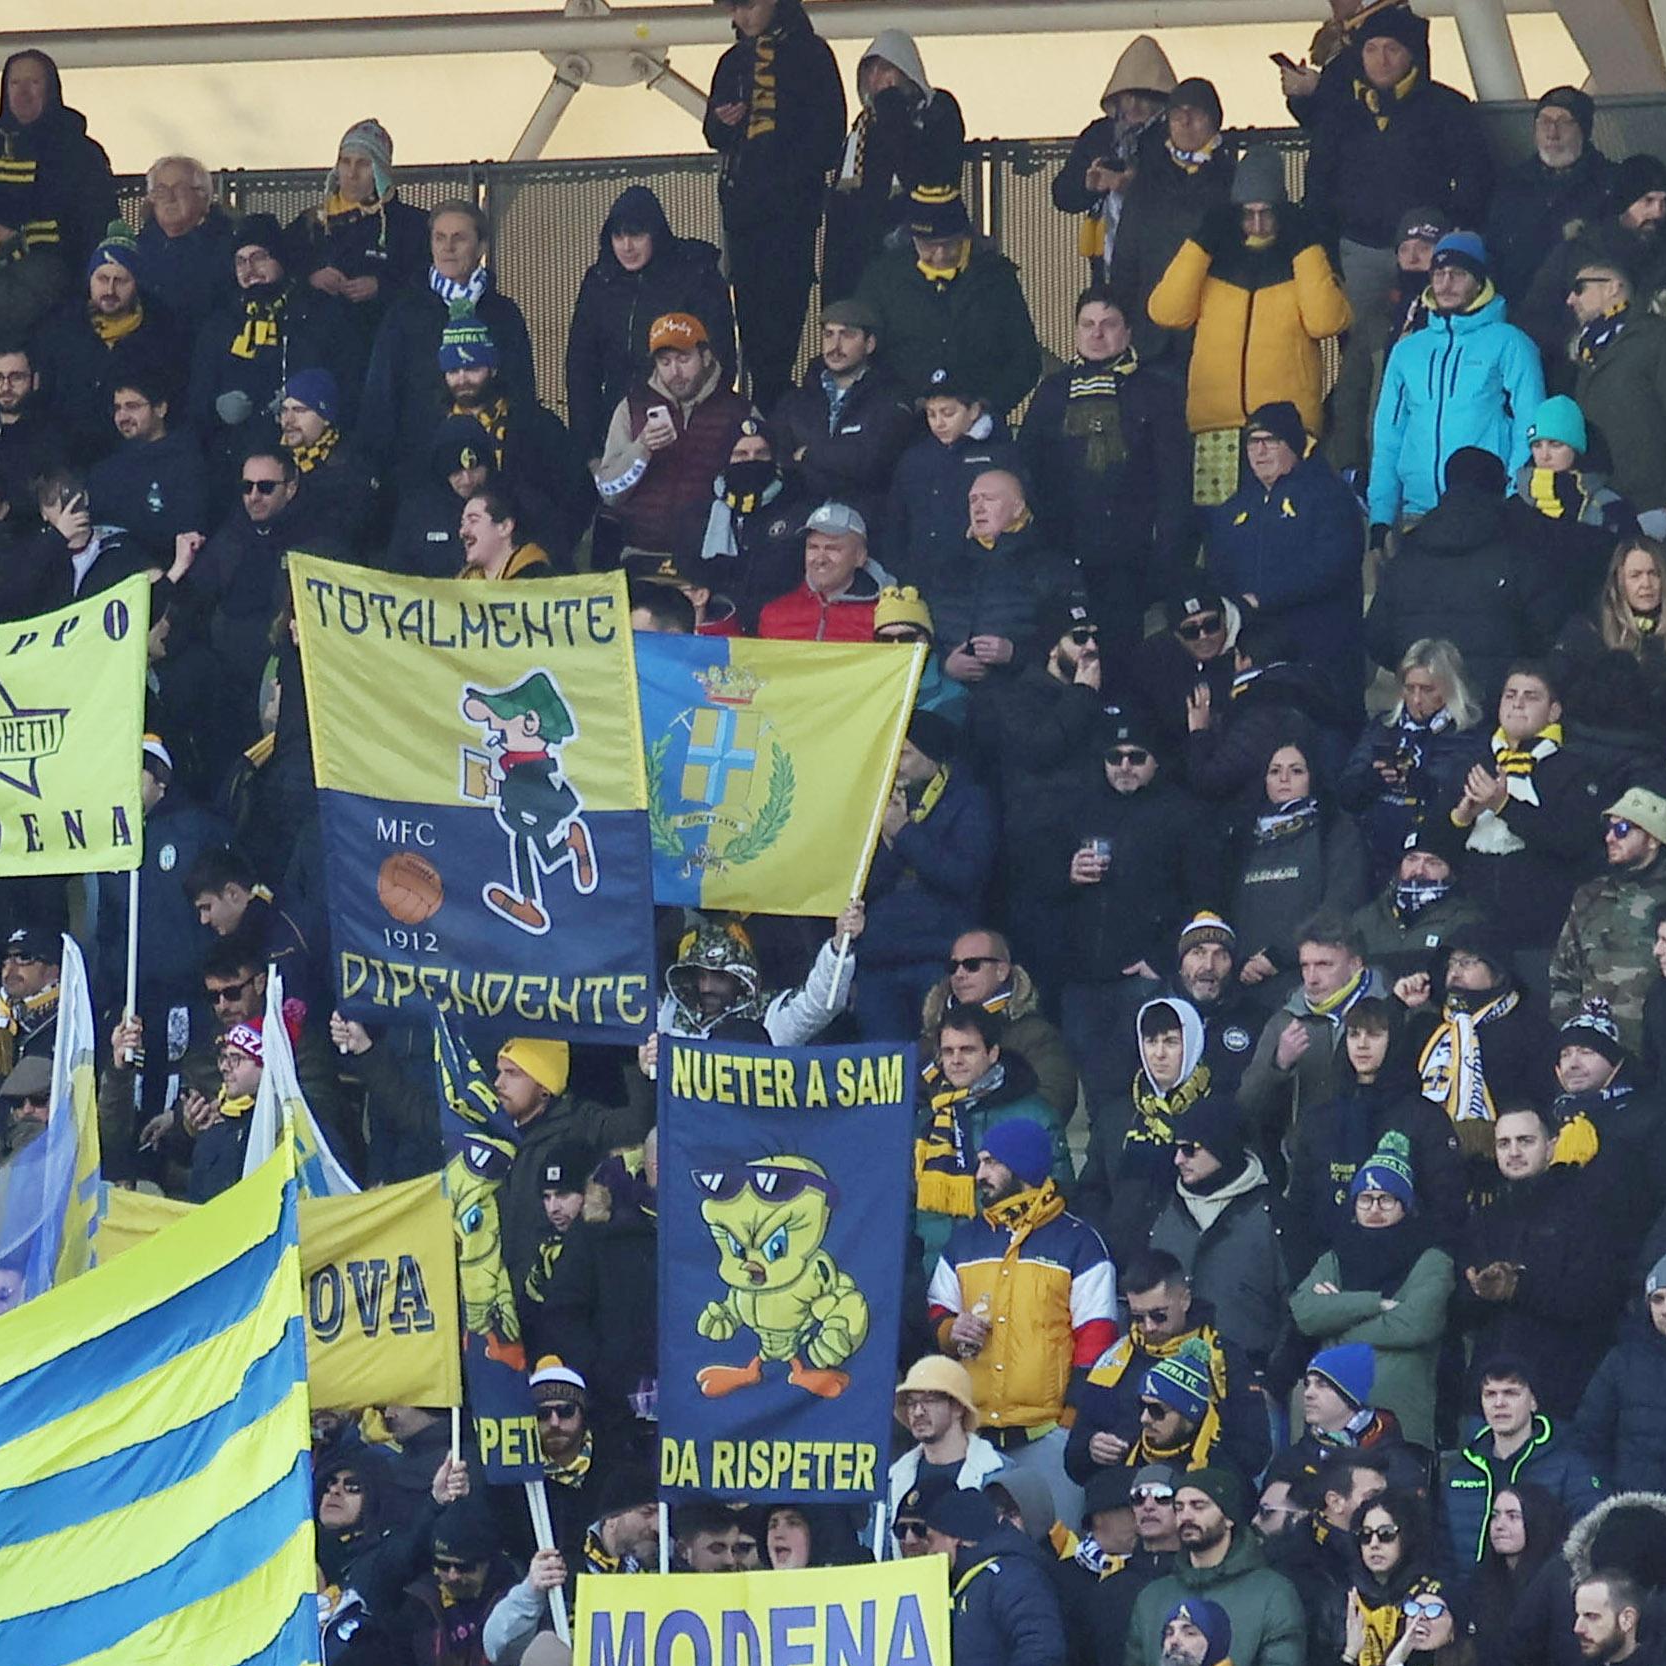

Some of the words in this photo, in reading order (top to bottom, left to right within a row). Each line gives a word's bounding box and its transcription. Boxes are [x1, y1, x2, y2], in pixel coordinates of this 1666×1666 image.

[306, 577, 618, 649] TOTALMENTE
[375, 817, 435, 847] MFC
[383, 927, 440, 952] 1912
[340, 950, 648, 1024] DIPENDENTE
[671, 1047, 795, 1108] NUETER
[806, 1061, 828, 1108] A
[836, 1054, 903, 1106] SAM
[308, 1254, 436, 1343] OVA
[473, 1417, 543, 1466] PET
[661, 1436, 704, 1488] DA
[711, 1442, 877, 1492] RISPETER
